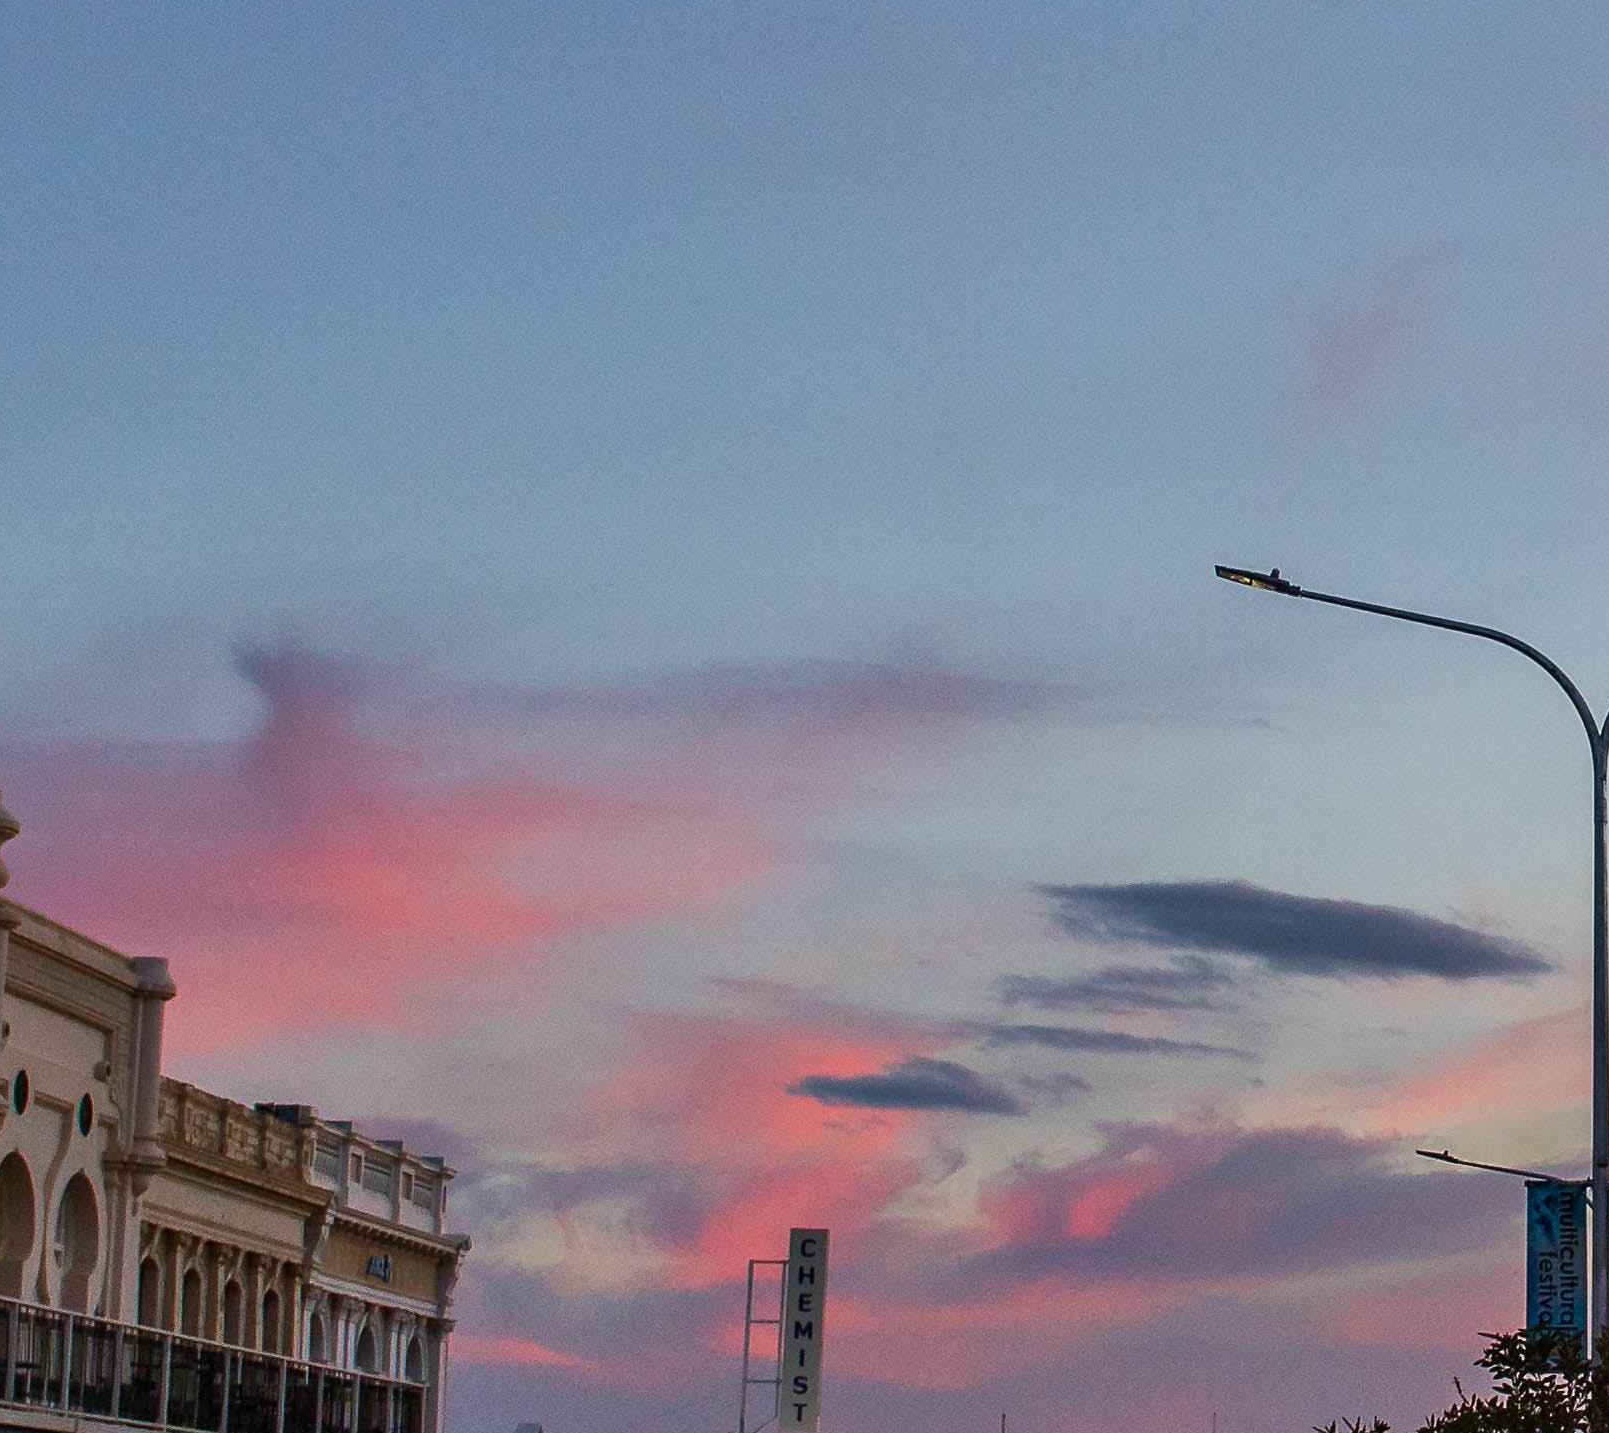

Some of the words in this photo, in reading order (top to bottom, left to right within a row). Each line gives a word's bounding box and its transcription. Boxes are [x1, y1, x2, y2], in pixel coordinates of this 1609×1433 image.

[793, 1238, 816, 1423] CHEMIST
[1539, 1251, 1557, 1330] festiva
[1560, 1191, 1578, 1334] multicultural
